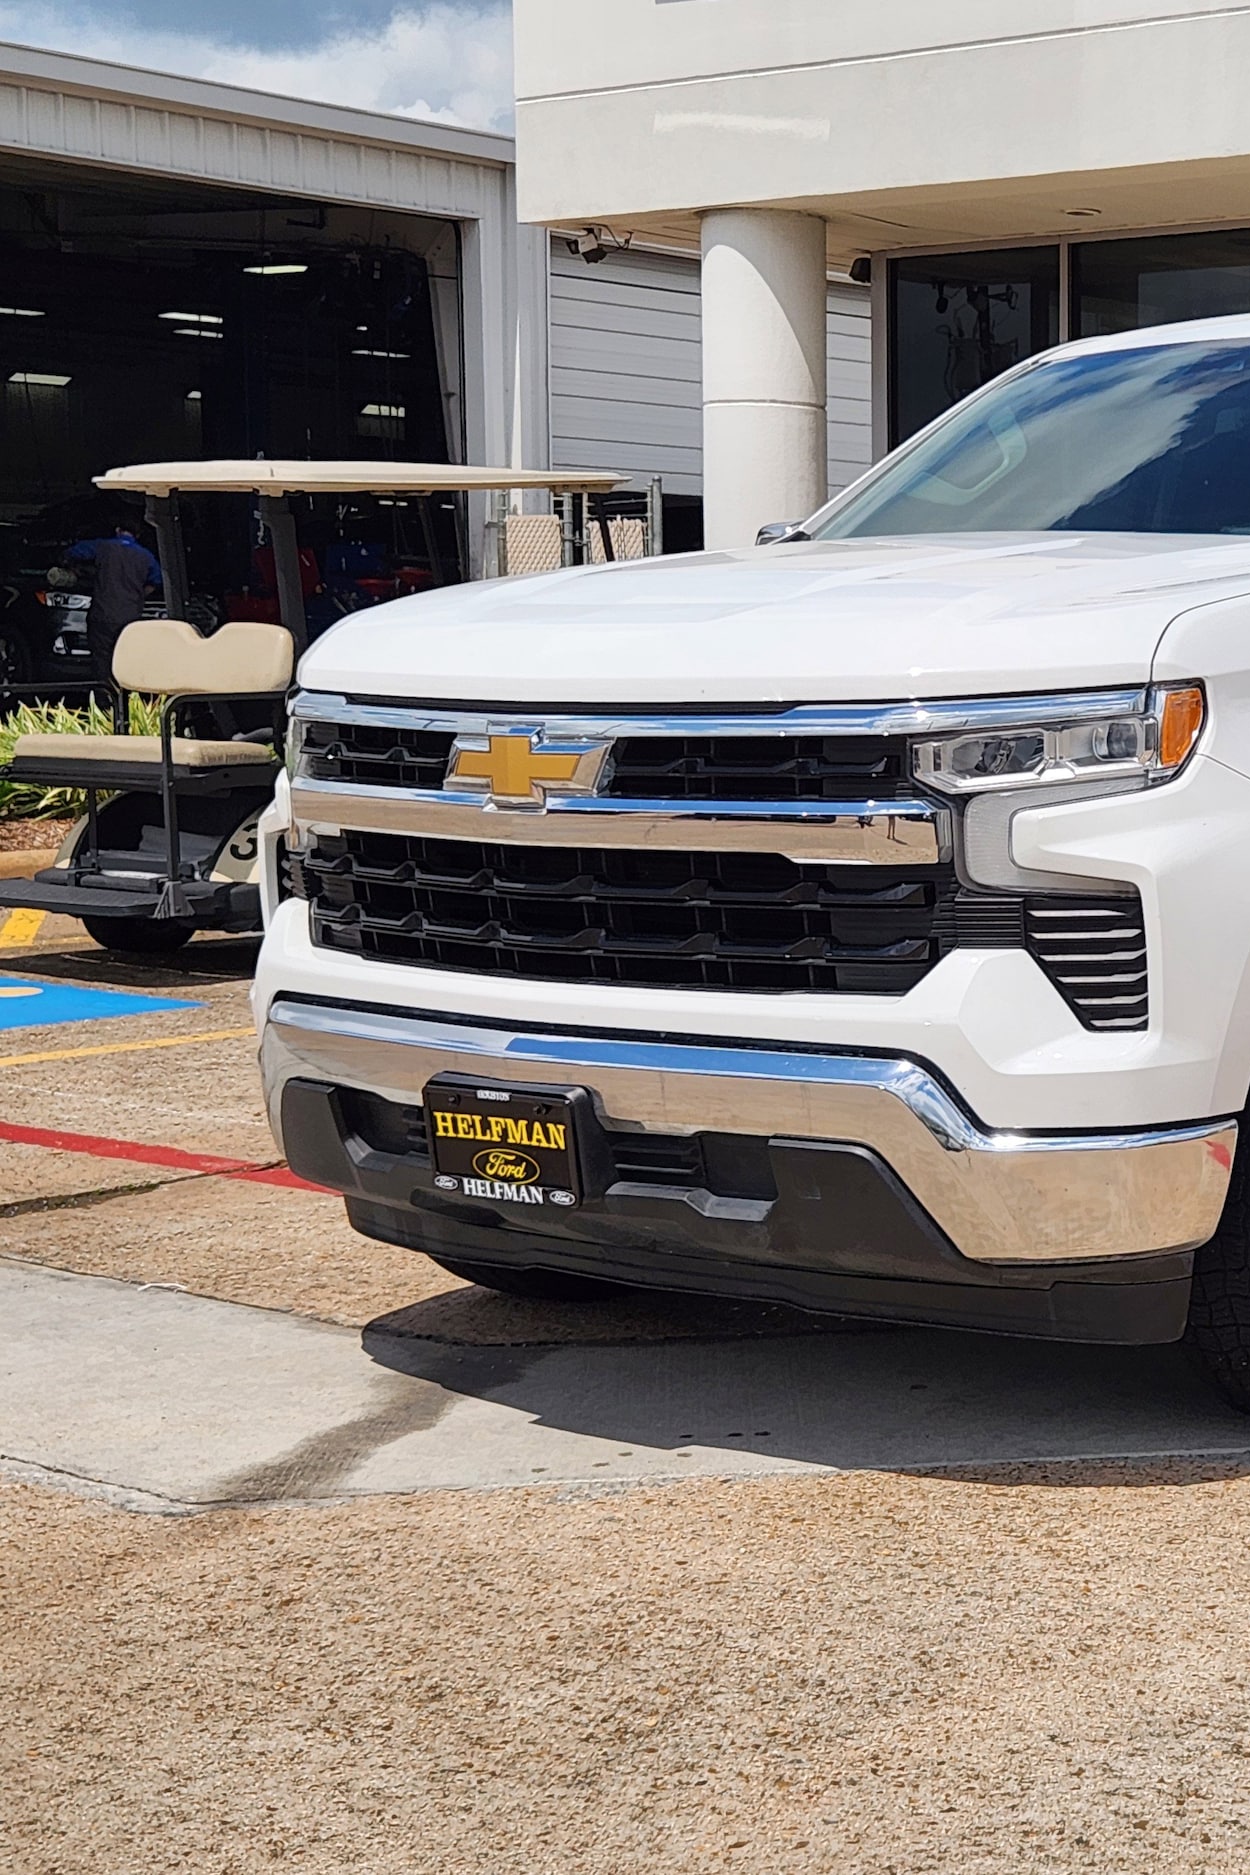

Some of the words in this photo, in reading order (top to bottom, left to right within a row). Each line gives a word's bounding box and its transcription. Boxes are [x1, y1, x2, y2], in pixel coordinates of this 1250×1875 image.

[433, 1111, 566, 1150] HELFMAN
[485, 1151, 527, 1179] Ford
[462, 1177, 545, 1204] HELFMAN
